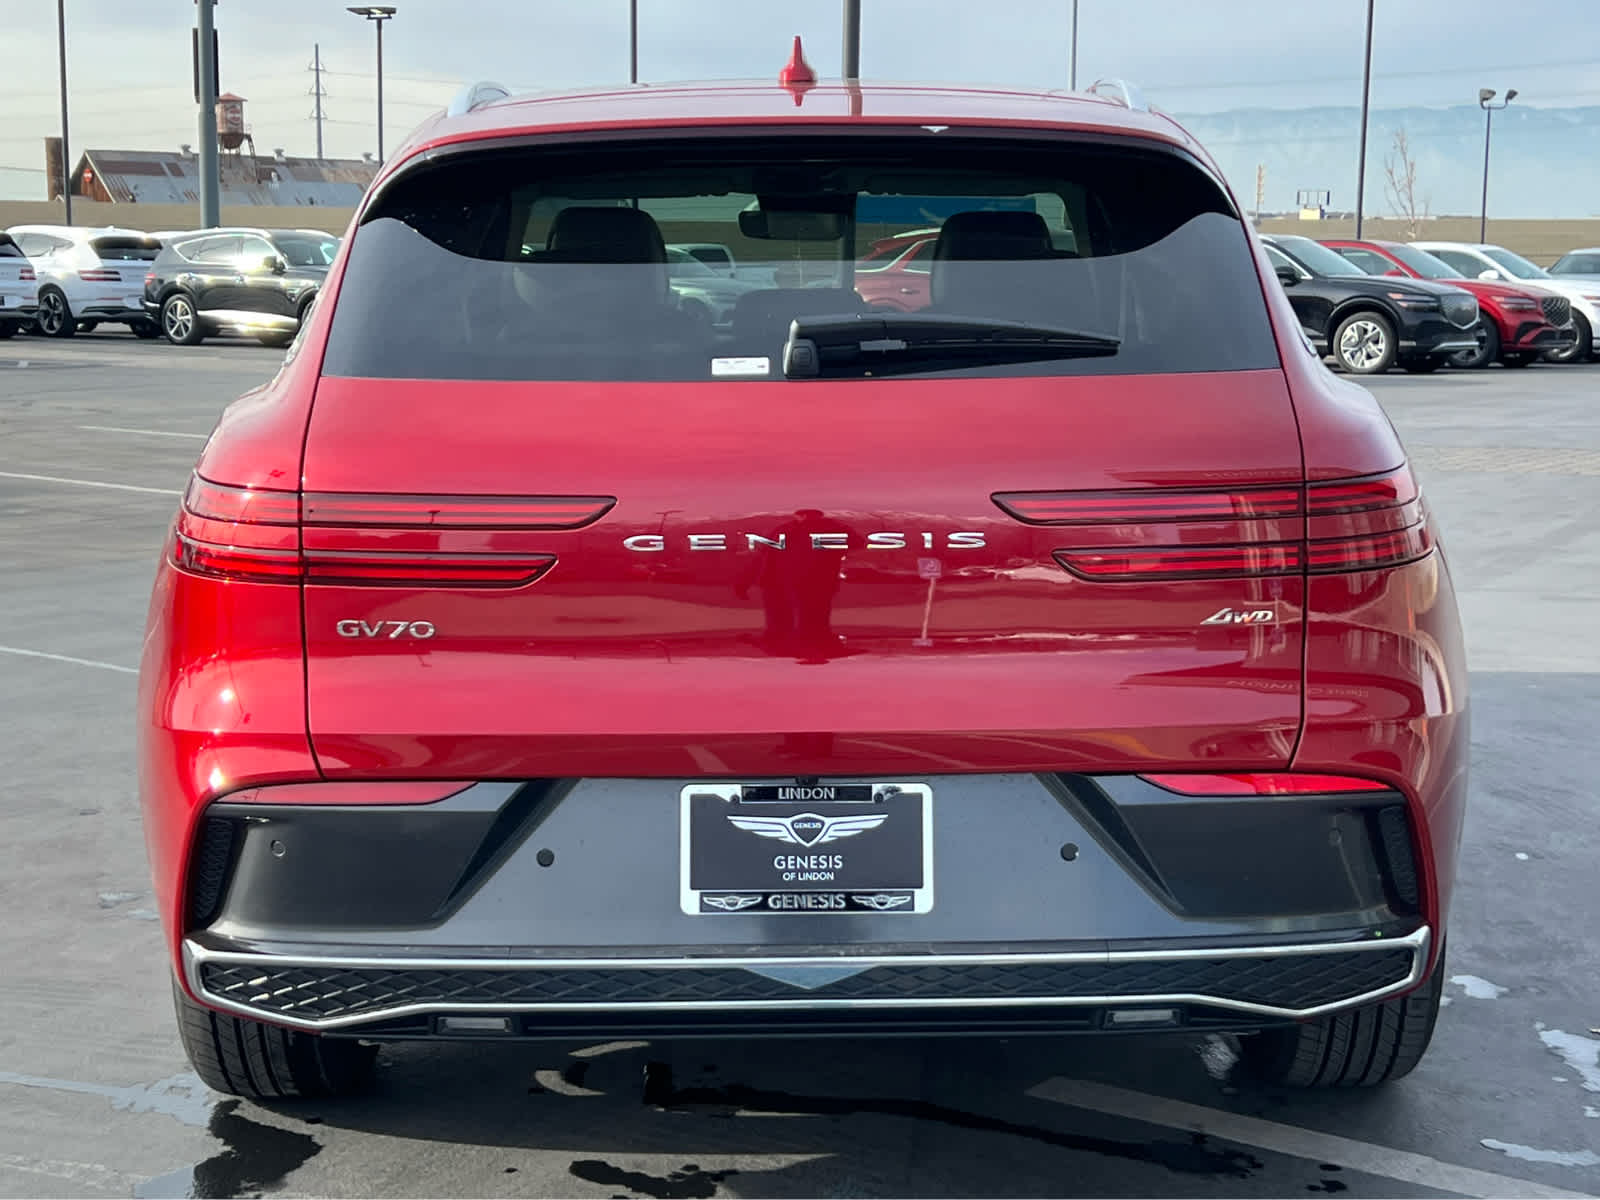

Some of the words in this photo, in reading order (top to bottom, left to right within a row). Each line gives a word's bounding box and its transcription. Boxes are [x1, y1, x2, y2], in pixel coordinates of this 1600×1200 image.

[623, 532, 986, 551] GENESIS
[1200, 607, 1273, 625] 4WD
[336, 619, 435, 638] GV70
[777, 787, 835, 800] LINDON
[793, 821, 822, 829] GENESIS
[773, 855, 843, 869] GENESIS
[782, 872, 796, 881] OF
[797, 872, 835, 881] LINDON
[767, 894, 847, 910] GENESIS
